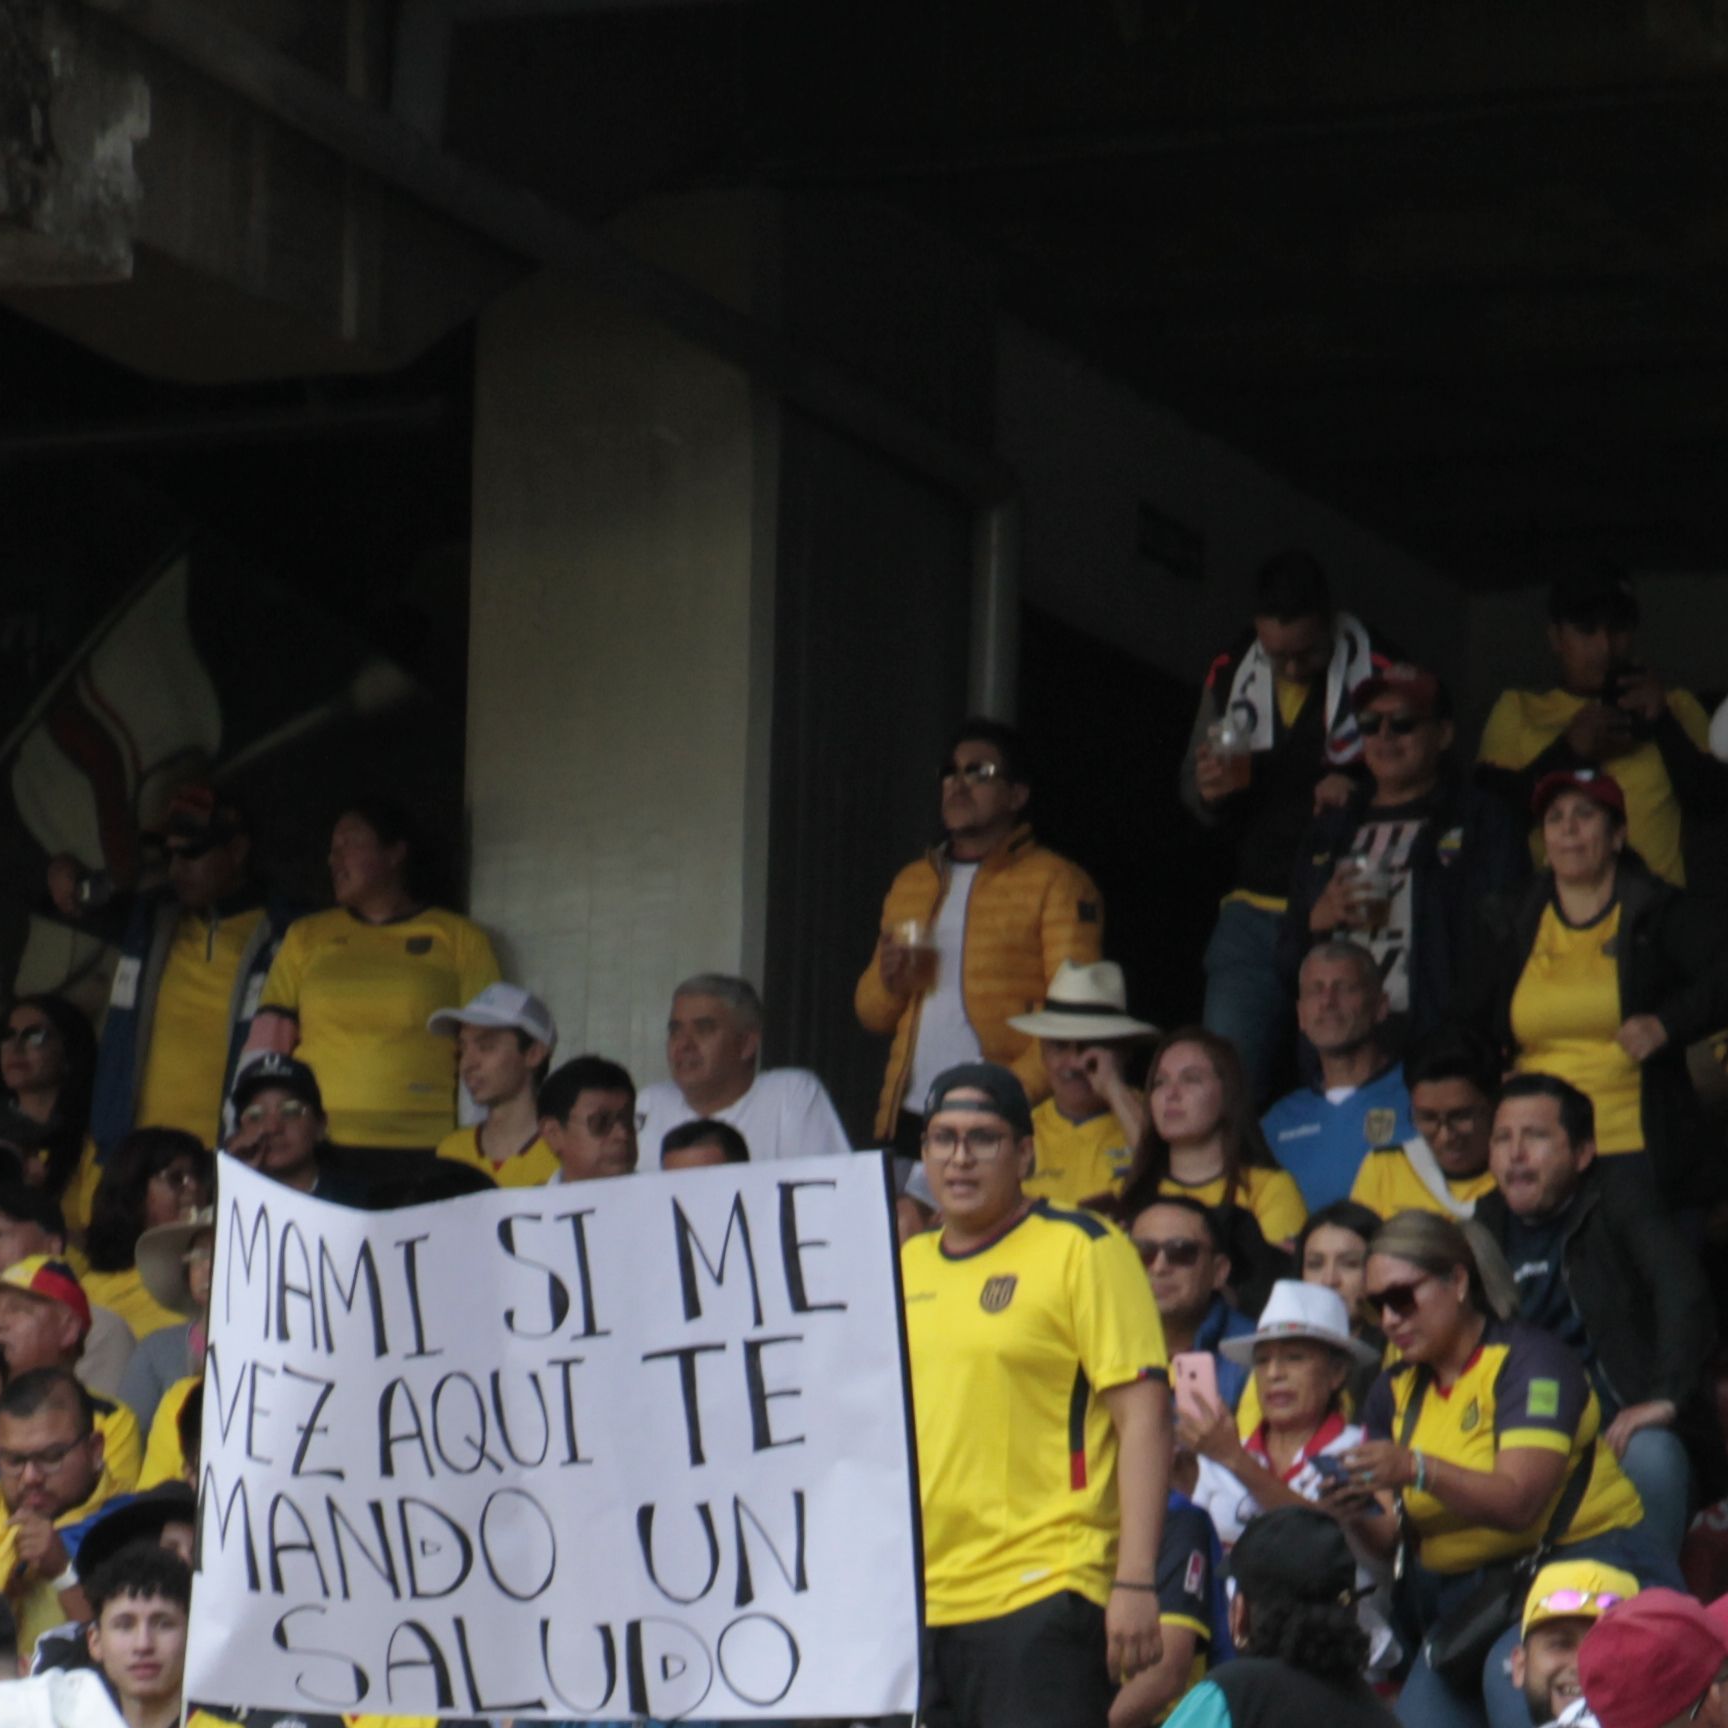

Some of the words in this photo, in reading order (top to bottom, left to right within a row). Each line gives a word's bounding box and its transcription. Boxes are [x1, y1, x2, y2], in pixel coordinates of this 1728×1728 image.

[224, 1198, 443, 1360] MAMI
[496, 1208, 611, 1341] SI
[672, 1180, 848, 1327] ME
[203, 1342, 345, 1481] VEZ
[378, 1356, 593, 1479] AQUI
[641, 1335, 806, 1468] TE
[197, 1464, 557, 1602] MANDO
[636, 1489, 809, 1607] UN
[272, 1604, 802, 1722] SALUDO
